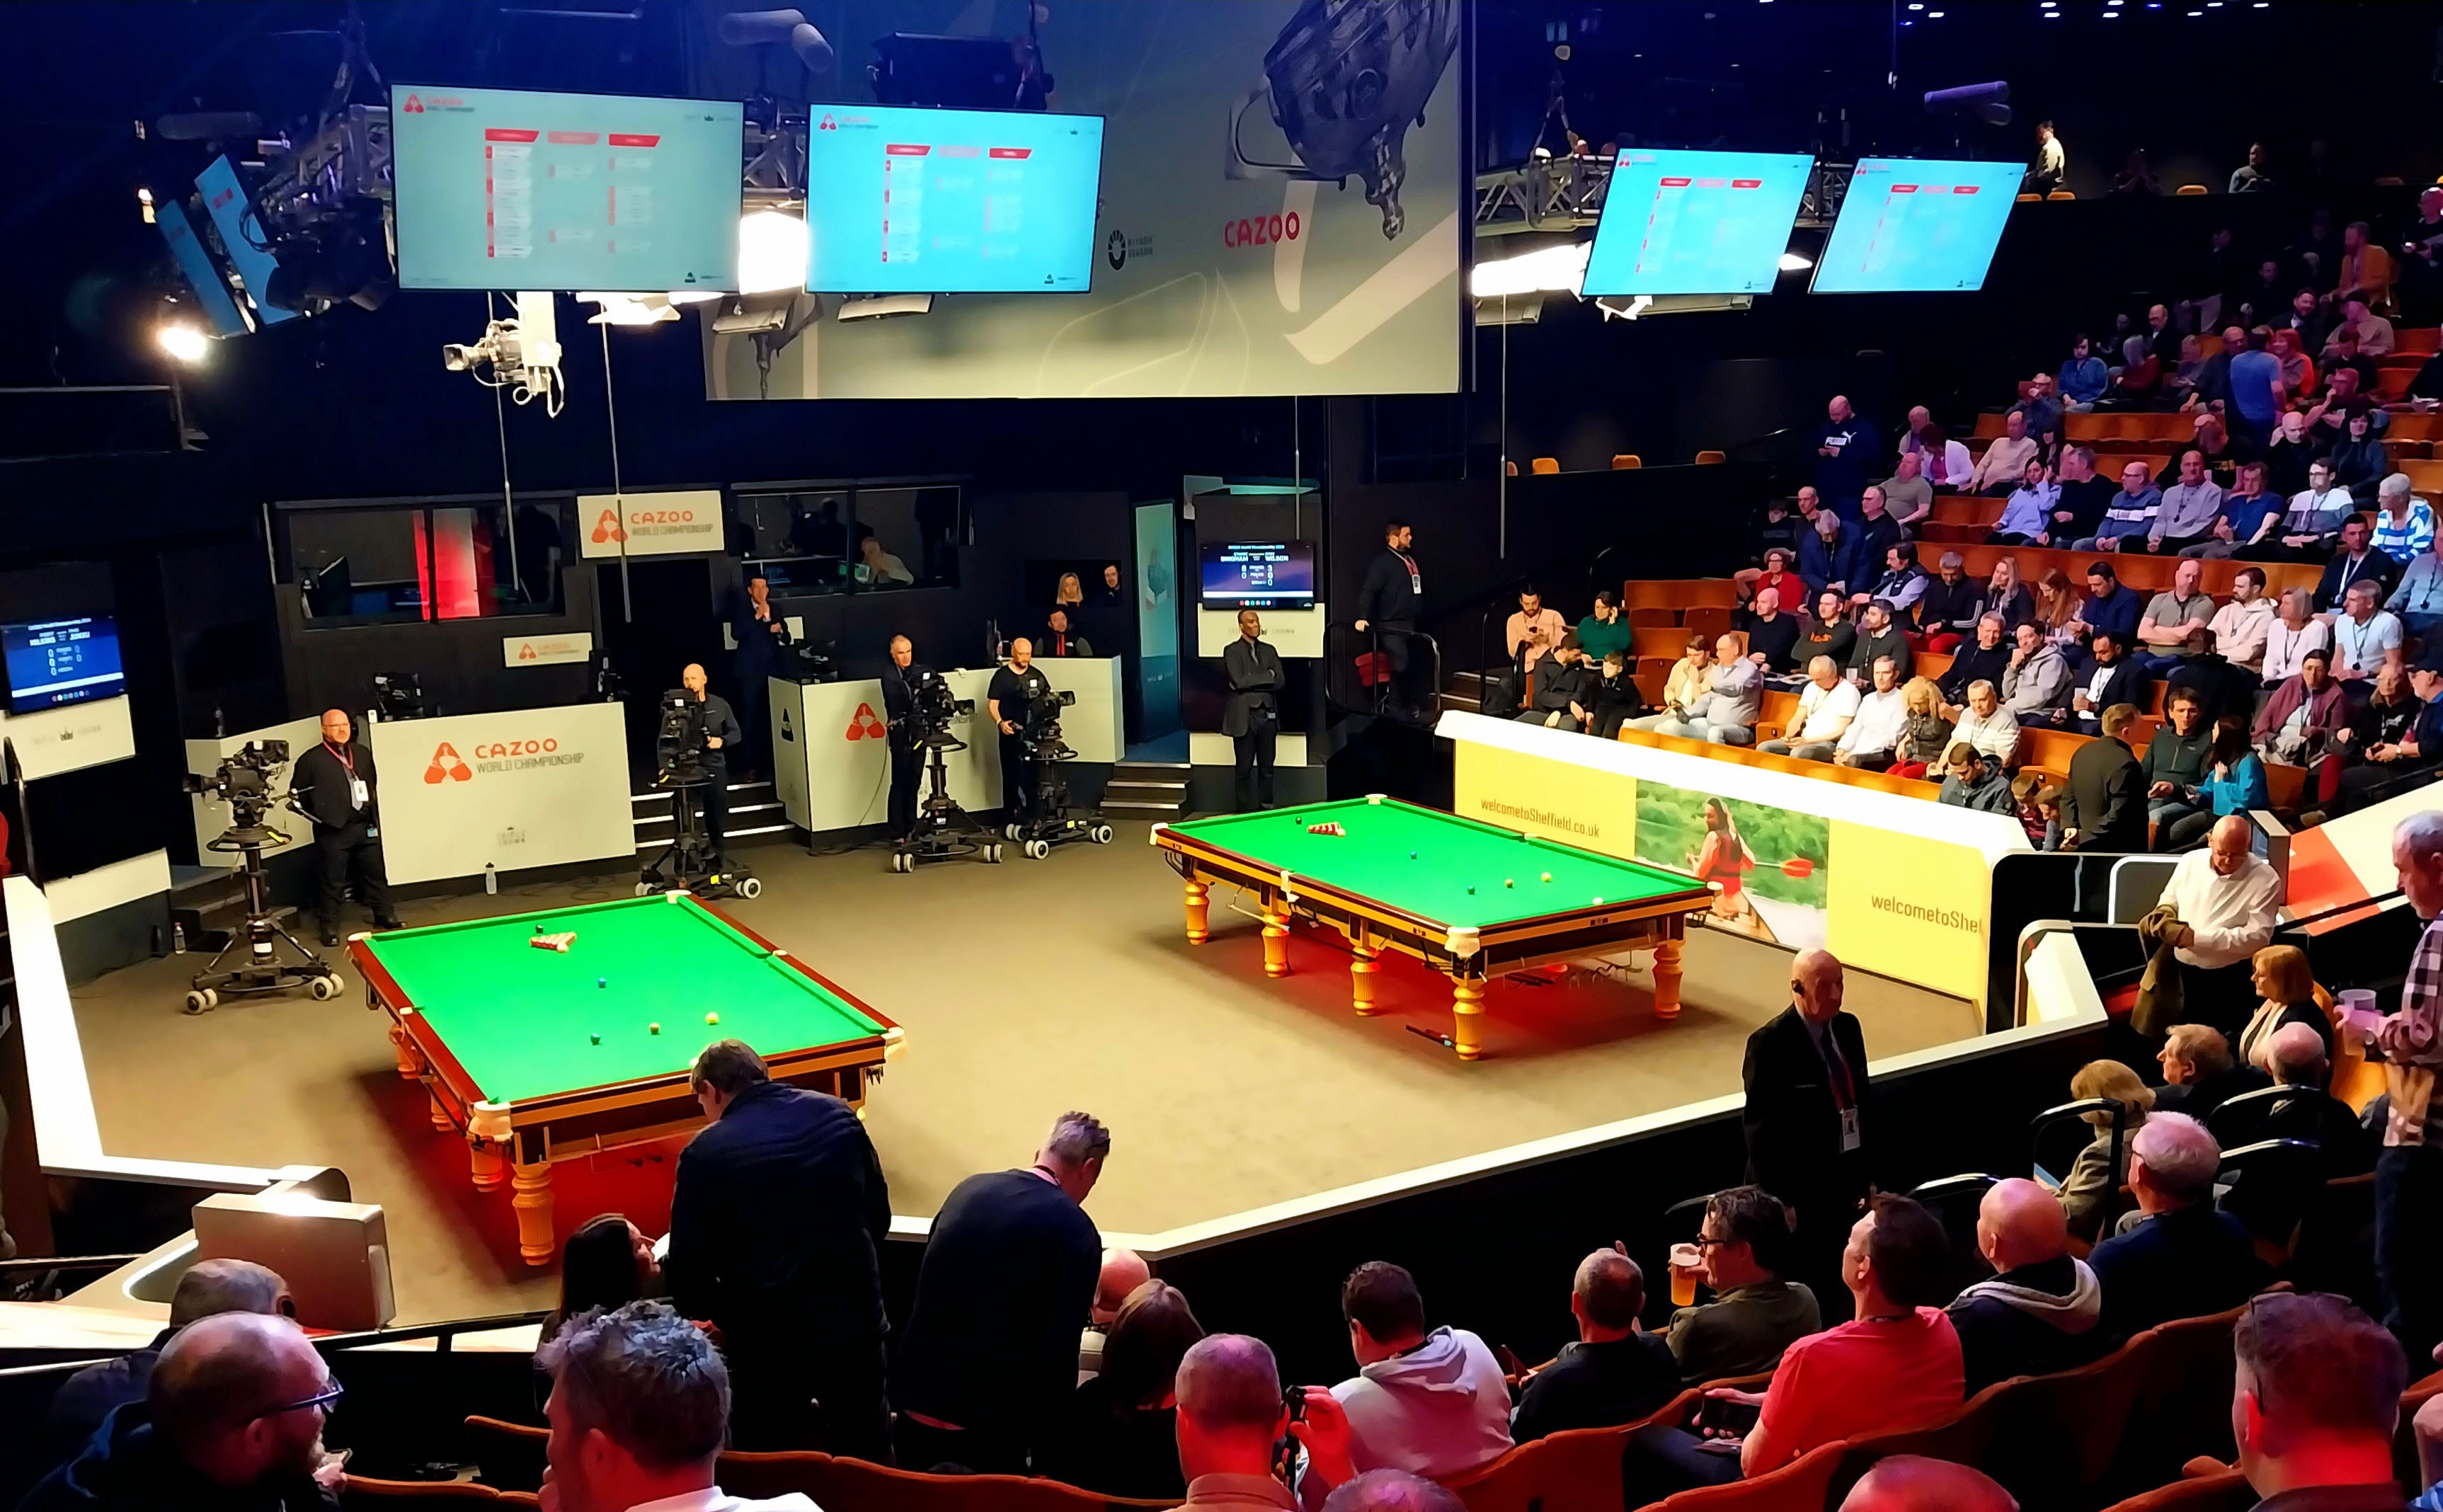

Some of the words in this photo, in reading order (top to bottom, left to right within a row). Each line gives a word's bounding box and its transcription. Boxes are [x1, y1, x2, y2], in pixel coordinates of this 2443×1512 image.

[1225, 212, 1300, 248] CAZOO
[631, 510, 693, 524] CAZOO
[631, 526, 658, 536] WORLD
[660, 524, 714, 535] CHAMPIONSHIP
[475, 738, 557, 759] CAZOO
[477, 760, 512, 773] WORLD
[515, 752, 584, 769] CHAMPIONSHIP
[1481, 798, 1599, 838] welcometoSheffield.co.uk
